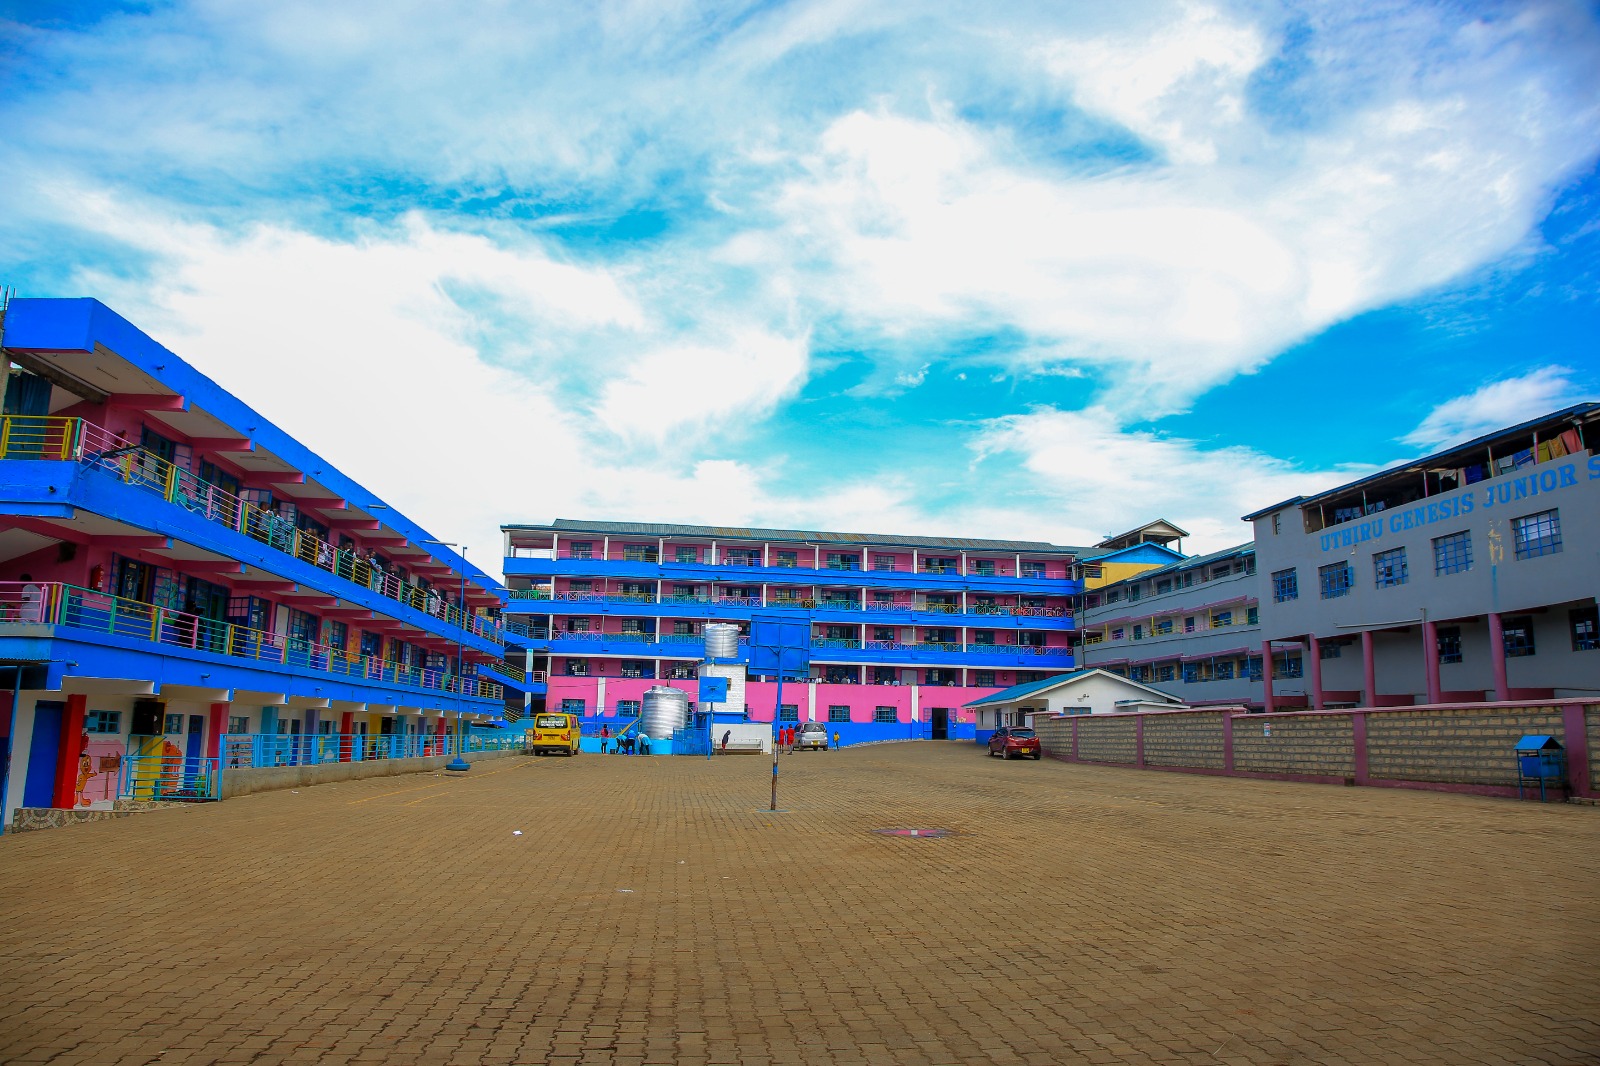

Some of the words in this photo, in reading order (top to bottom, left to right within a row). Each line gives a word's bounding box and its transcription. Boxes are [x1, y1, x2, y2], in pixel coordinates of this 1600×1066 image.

[1320, 517, 1384, 552] UTHIRU
[1389, 493, 1474, 534] GENESIS
[1482, 463, 1578, 508] JUNIOR
